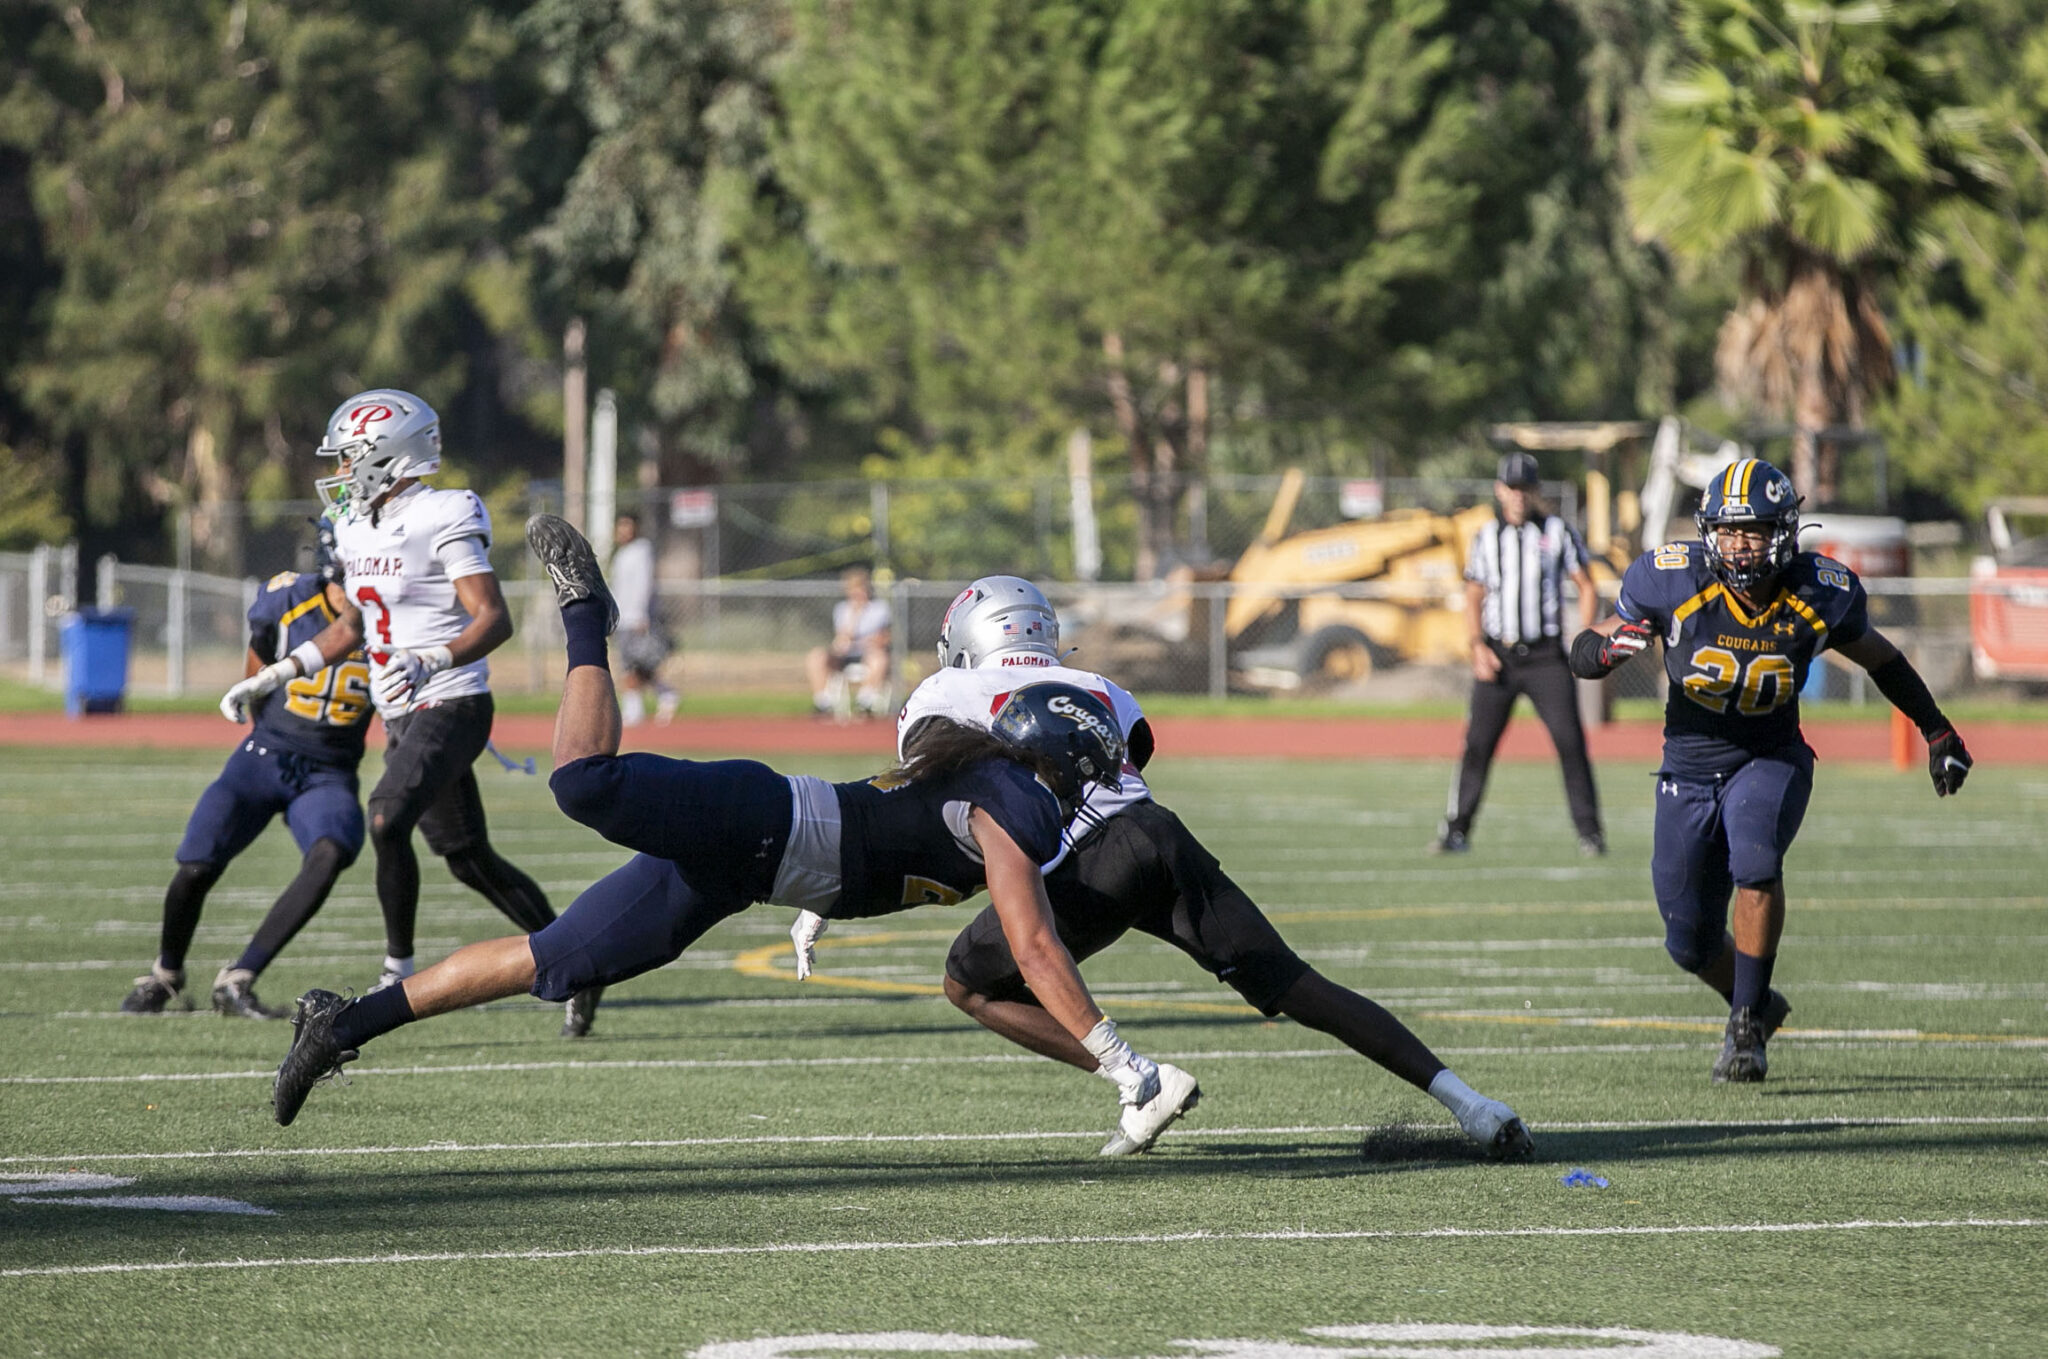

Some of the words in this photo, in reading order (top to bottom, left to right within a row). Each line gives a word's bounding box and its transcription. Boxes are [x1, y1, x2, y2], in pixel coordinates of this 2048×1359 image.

[350, 404, 393, 437] P
[356, 586, 392, 666] 3
[1717, 633, 1777, 651] COUGARS
[1001, 655, 1050, 667] PALOMAR
[1683, 646, 1794, 716] 20
[284, 660, 370, 726] 26
[1047, 696, 1117, 754] Cougars
